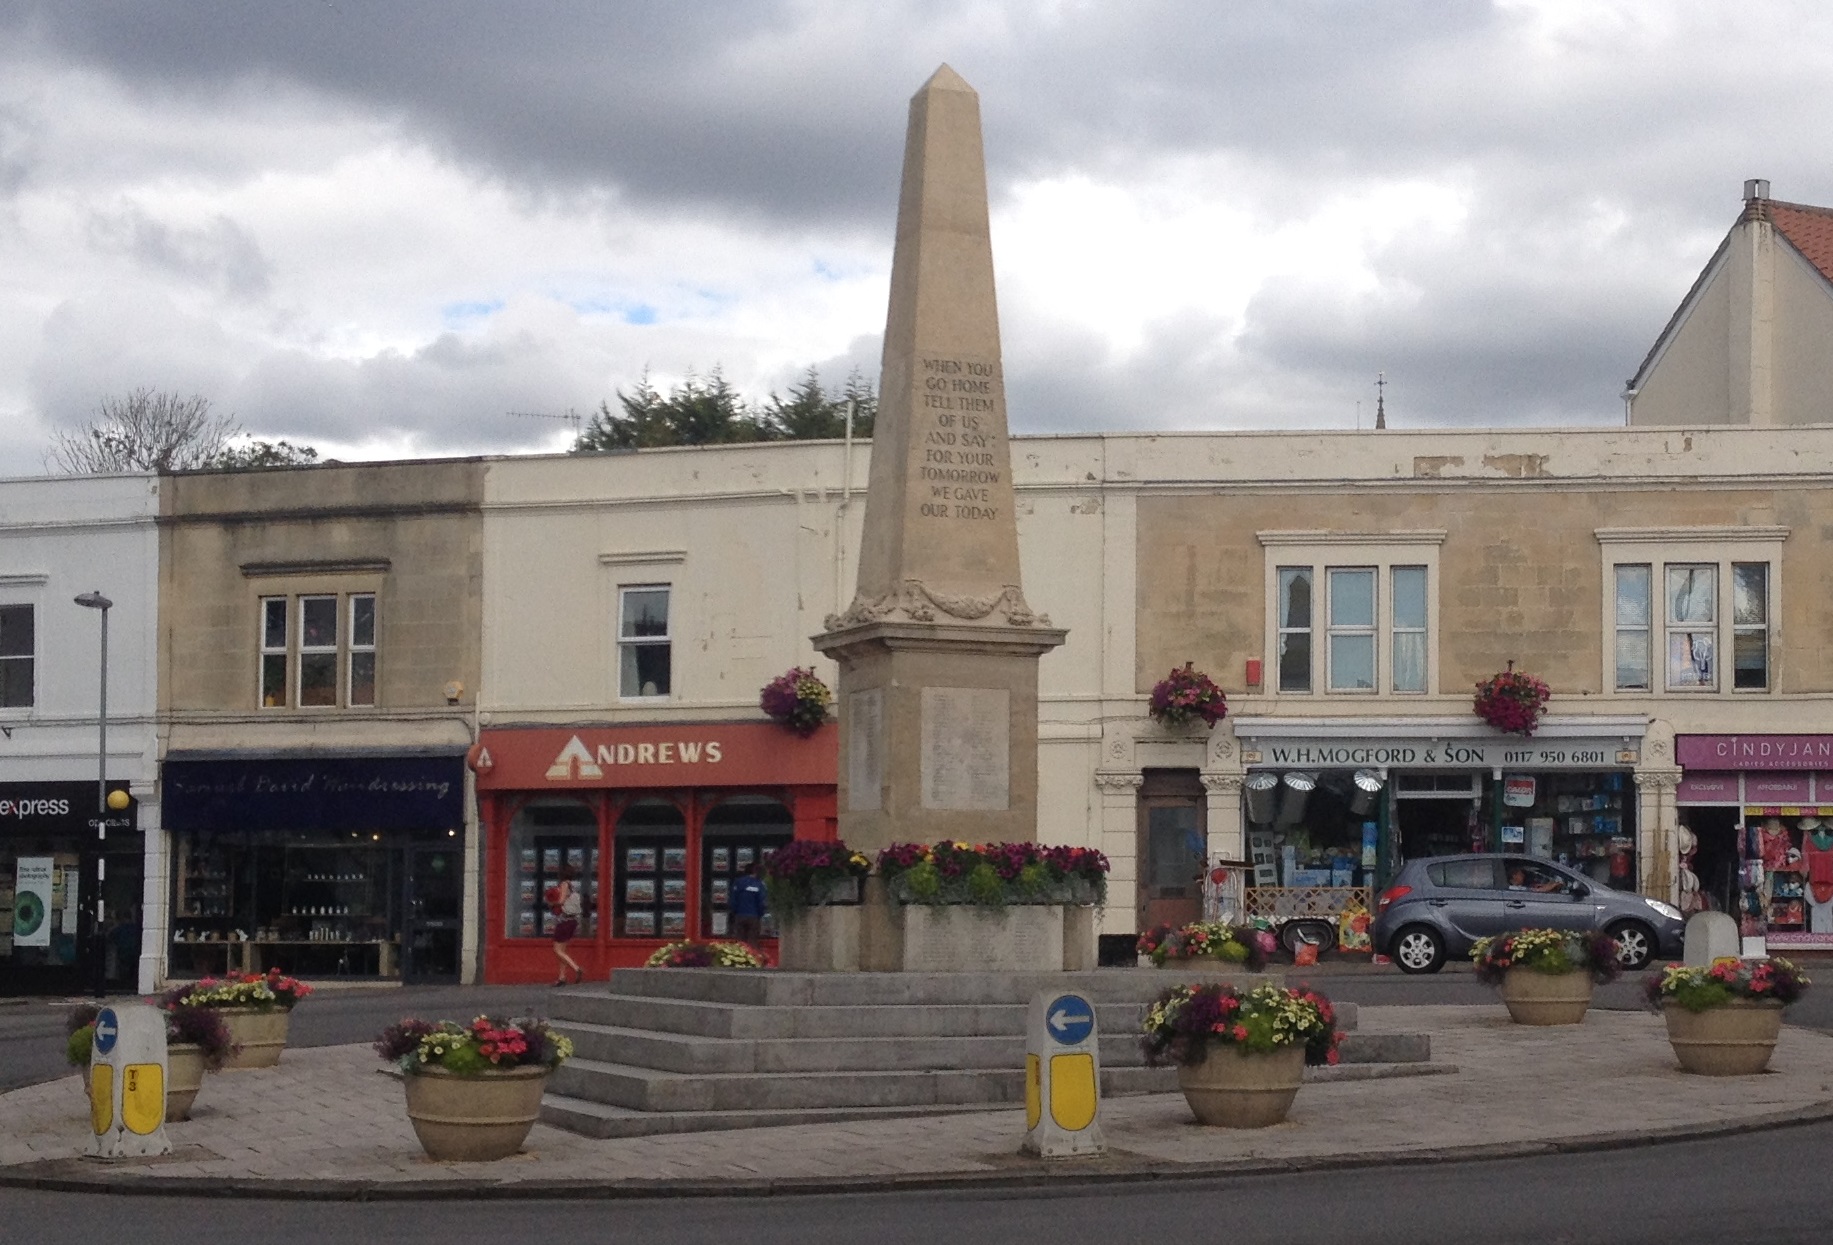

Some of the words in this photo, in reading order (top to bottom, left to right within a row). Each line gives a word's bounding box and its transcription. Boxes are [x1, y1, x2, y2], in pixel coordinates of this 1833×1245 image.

[923, 359, 962, 374] WHEN
[967, 362, 993, 377] YOU
[925, 377, 947, 390] GO
[952, 380, 991, 394] HOME
[924, 394, 954, 410] TELL
[958, 397, 994, 412] THEM
[938, 414, 956, 428] OF
[962, 416, 979, 431] US
[925, 431, 956, 446] AND
[926, 449, 953, 464] FOR
[957, 451, 994, 467] YOUR
[920, 466, 1000, 484] TOMORROW
[931, 486, 951, 500] WE
[954, 487, 989, 502] GAVE
[920, 503, 949, 518] OUR
[955, 505, 998, 520] TODAY
[1424, 749, 1436, 763] &
[1444, 748, 1484, 763] SON
[1504, 751, 1533, 763] 0117
[1540, 751, 1565, 763] 950
[1571, 751, 1604, 763] 6801
[0, 799, 69, 819] express
[129, 1070, 137, 1079] T
